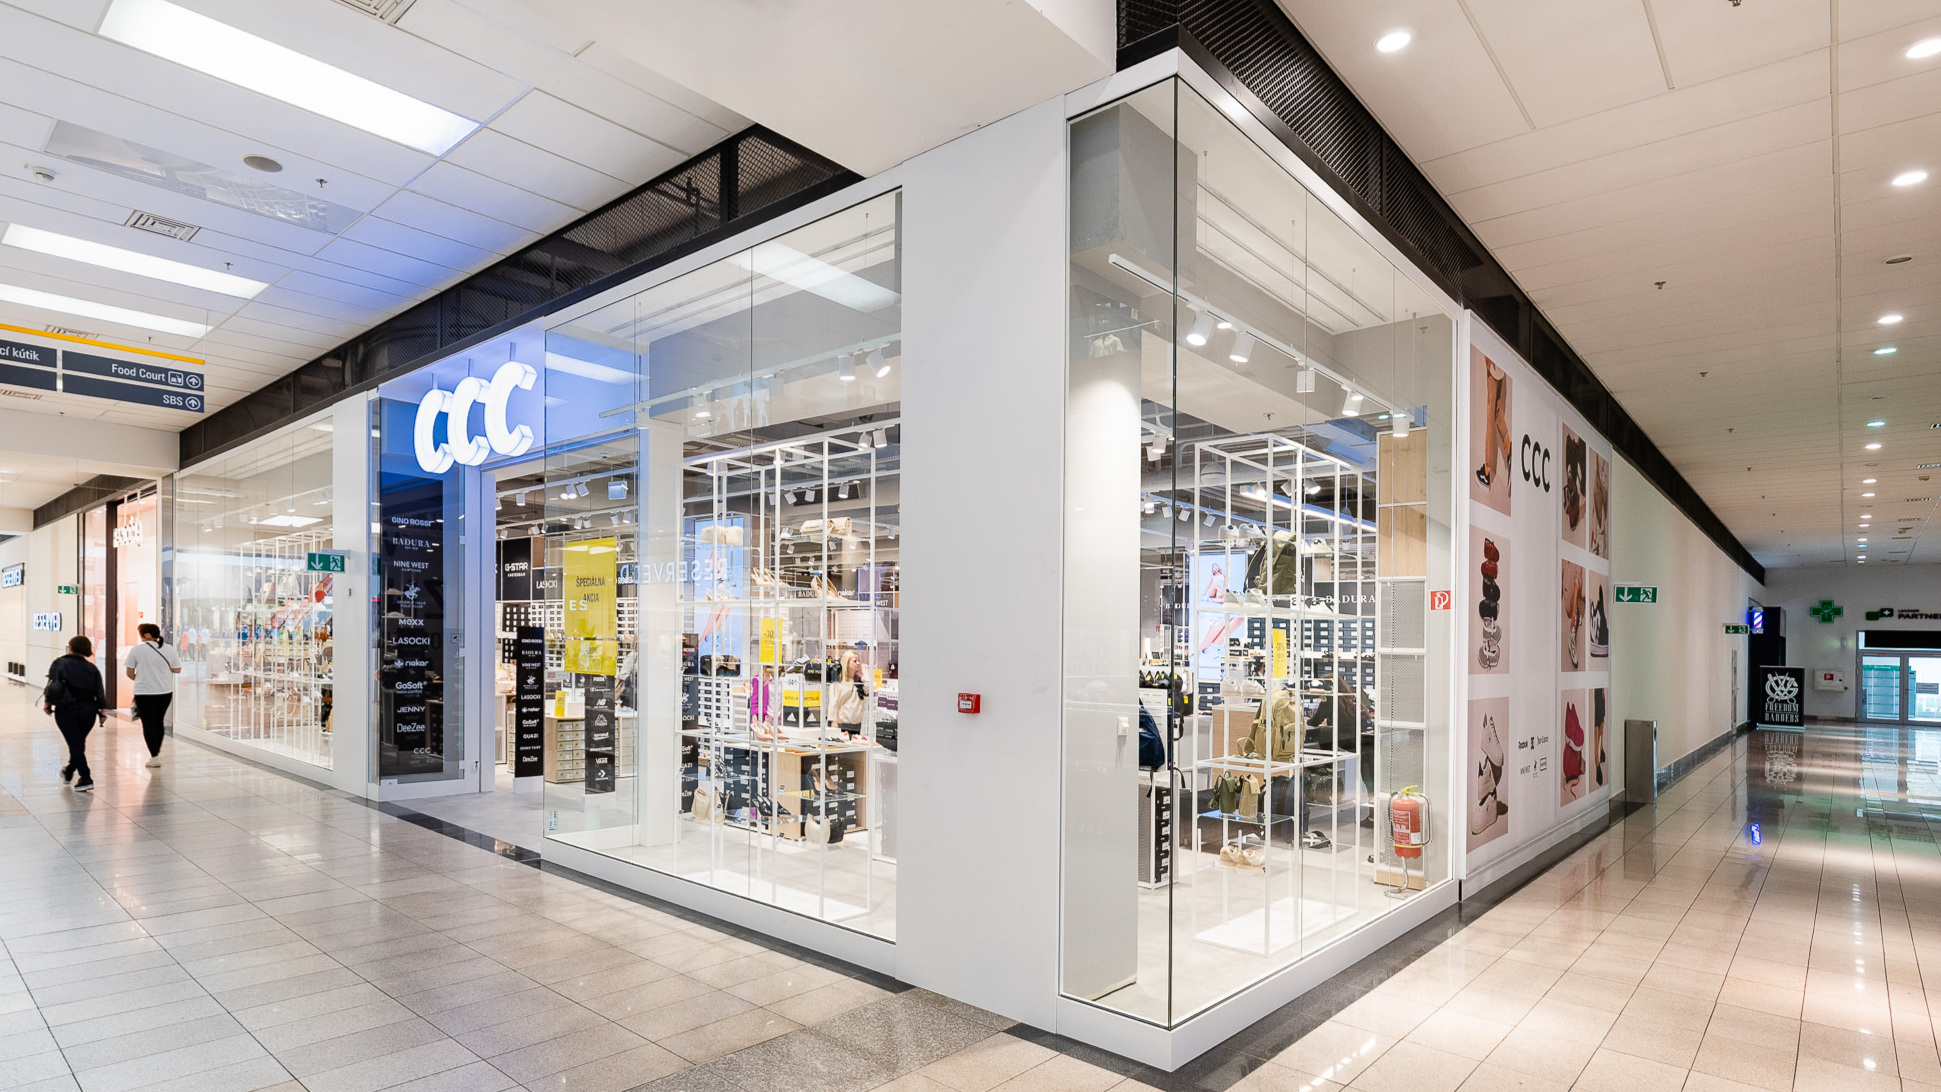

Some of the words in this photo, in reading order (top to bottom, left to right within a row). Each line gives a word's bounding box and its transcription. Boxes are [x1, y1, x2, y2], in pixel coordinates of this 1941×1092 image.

[12, 347, 39, 361] kútik
[111, 363, 136, 377] Food
[139, 368, 166, 382] Court
[163, 395, 183, 406] SBS
[414, 361, 538, 474] CCC
[1521, 433, 1551, 494] CCC
[410, 518, 431, 527] ROSSI
[393, 537, 430, 548] BADURA
[411, 561, 429, 569] WEST
[505, 562, 529, 571] G-STAR
[576, 575, 606, 588] ŠPECIÁLNA
[393, 636, 430, 645] LASOCKI
[1765, 703, 1799, 712] FREEDOM
[1765, 713, 1799, 723] BARBERS
[397, 723, 425, 733] DeeZee
